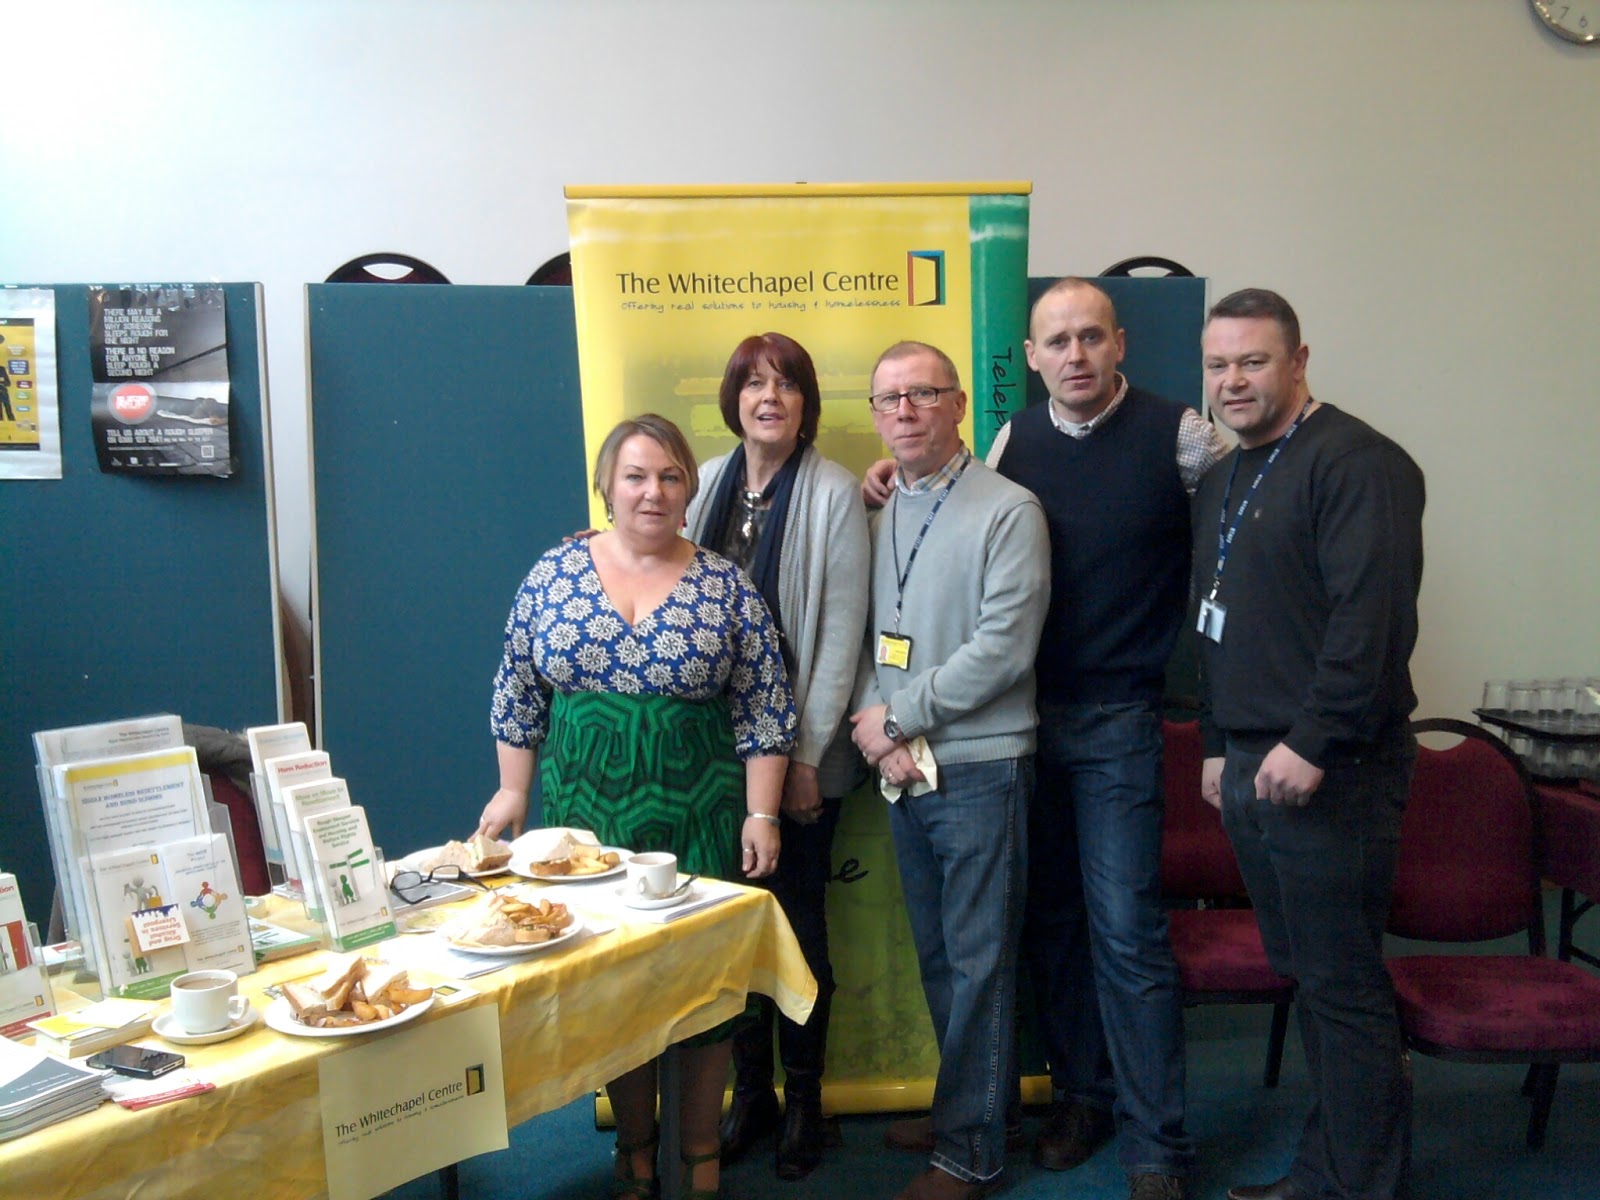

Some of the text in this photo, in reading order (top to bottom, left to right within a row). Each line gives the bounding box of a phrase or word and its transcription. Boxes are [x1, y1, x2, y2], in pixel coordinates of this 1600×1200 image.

[1560, 6, 1570, 20] 7
[616, 270, 898, 296] The Whitechapel Centre
[671, 301, 694, 310] real
[702, 300, 744, 310] solutions
[752, 301, 762, 310] to
[768, 301, 806, 312] housing
[826, 299, 900, 308] homelessness
[984, 346, 1016, 431] Telep
[335, 1121, 357, 1137] The
[359, 1092, 425, 1129] Whitechapel
[428, 1081, 462, 1102] Centre
